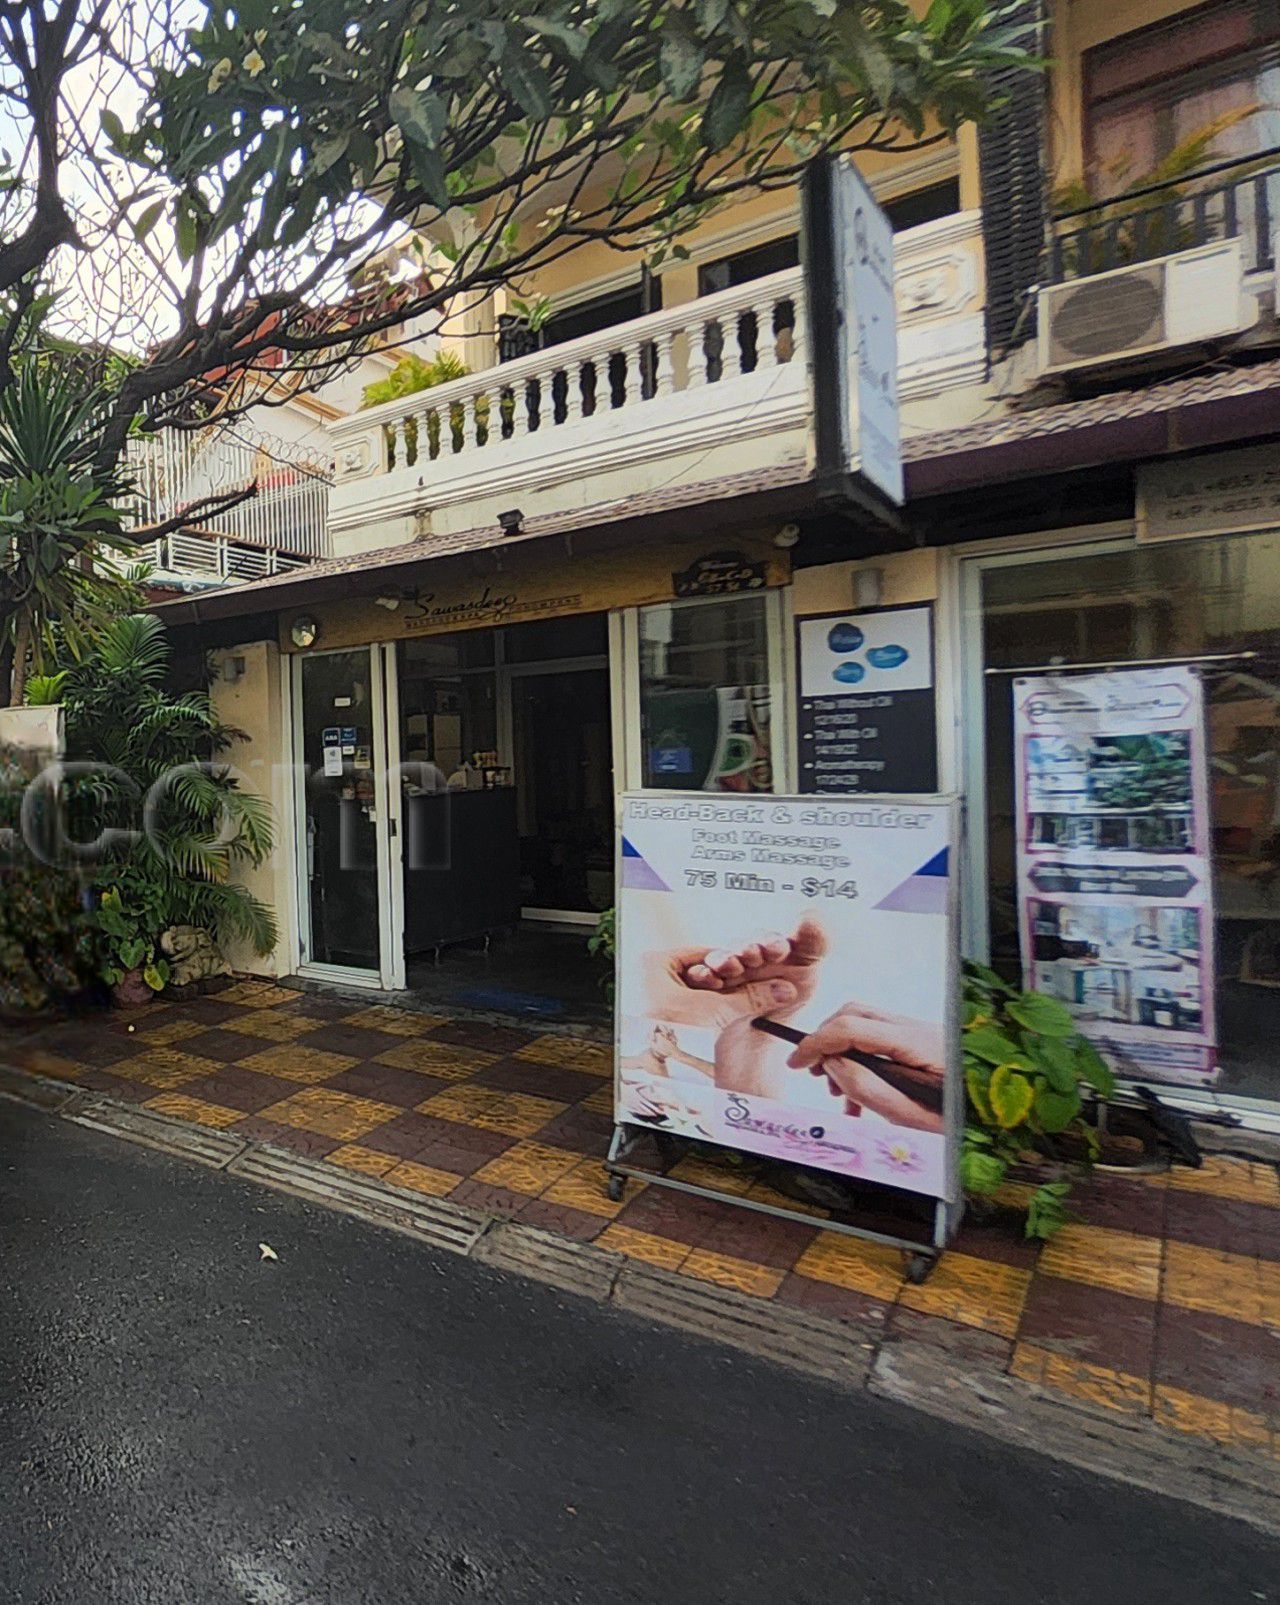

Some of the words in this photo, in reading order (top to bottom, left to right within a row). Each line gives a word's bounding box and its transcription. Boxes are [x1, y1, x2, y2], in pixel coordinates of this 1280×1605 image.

[629, 801, 764, 824] Head-Back
[771, 806, 792, 825] &
[800, 806, 934, 829] shoulder
[691, 827, 739, 844] Foot
[742, 830, 842, 851] Massage
[691, 846, 745, 862] Arms
[750, 847, 851, 869] Massage
[684, 868, 718, 888] 75
[724, 872, 775, 892] Min
[800, 877, 859, 899] $14
